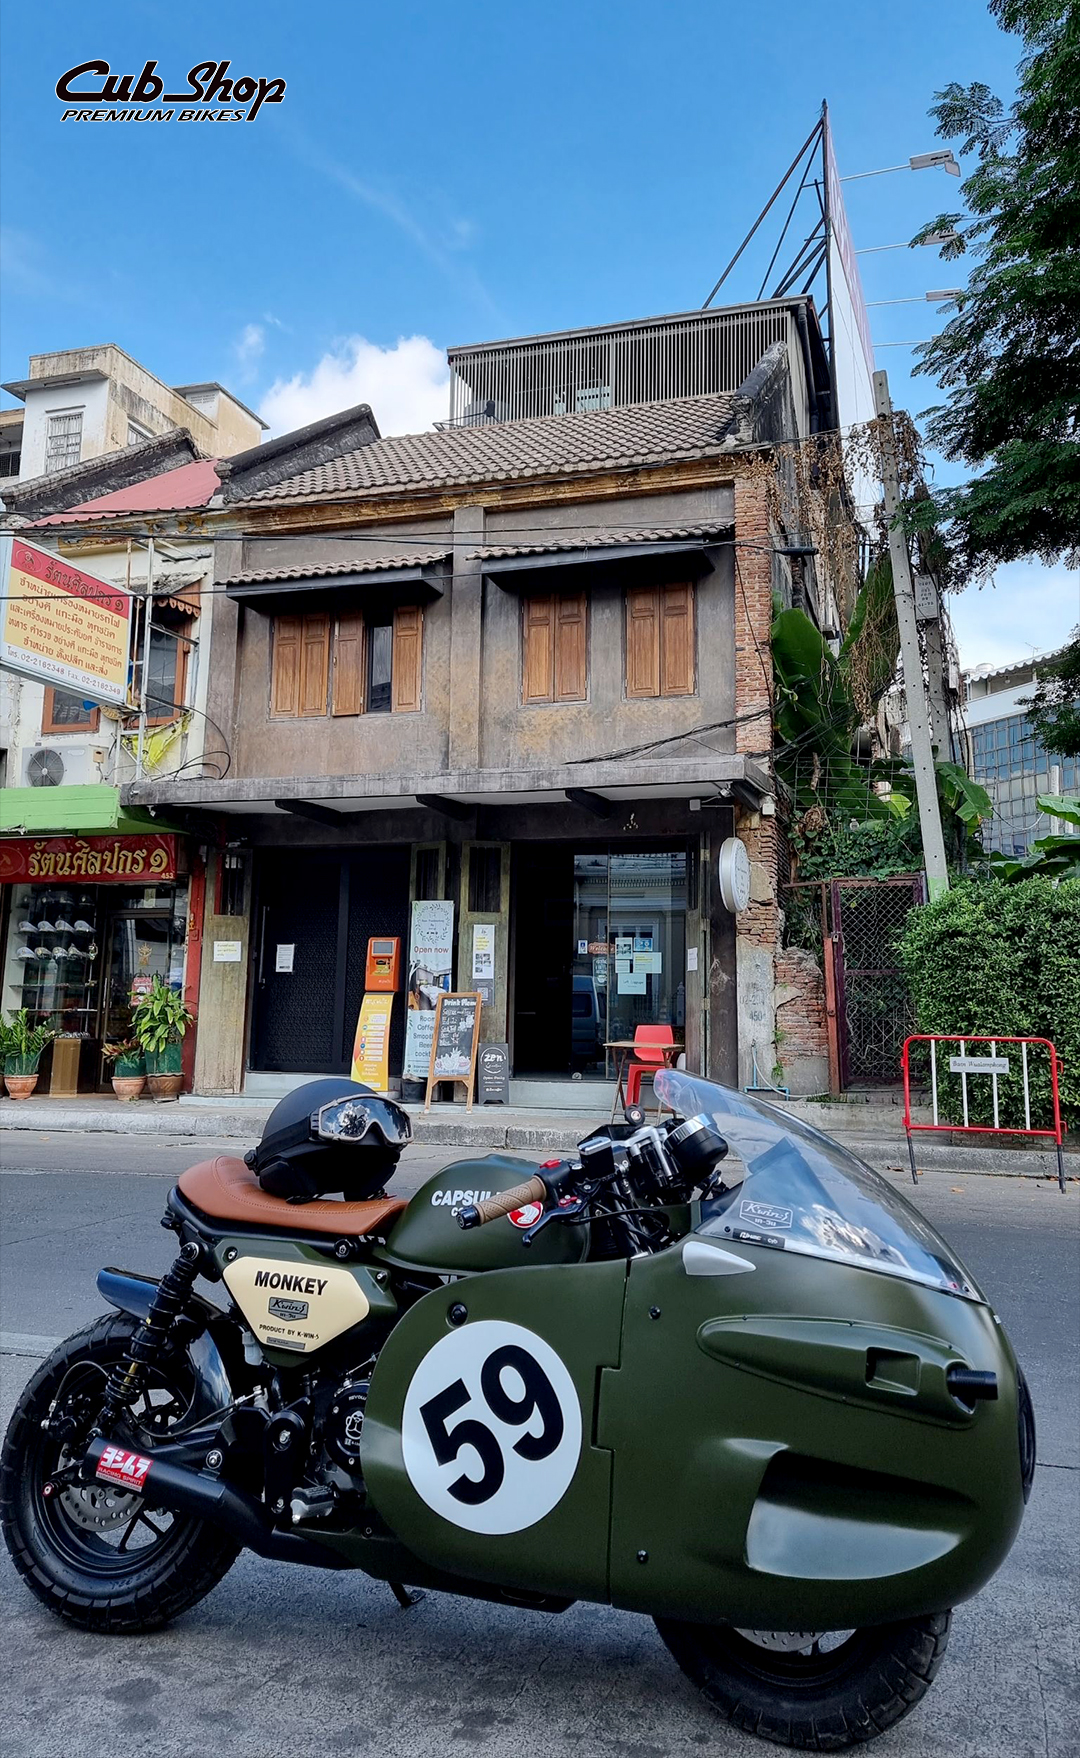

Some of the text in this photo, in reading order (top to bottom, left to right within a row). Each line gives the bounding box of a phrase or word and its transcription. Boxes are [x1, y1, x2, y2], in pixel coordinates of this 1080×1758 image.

[28, 840, 169, 877] รัตนศิลปกร ๑
[413, 945, 450, 955] Open now
[254, 1270, 329, 1296] MONKEY
[258, 1323, 286, 1335] PRODUCT
[419, 1344, 565, 1506] 59
[100, 1446, 151, 1479] ヨシムラ
[98, 1467, 142, 1486] RACING SPIRIT
